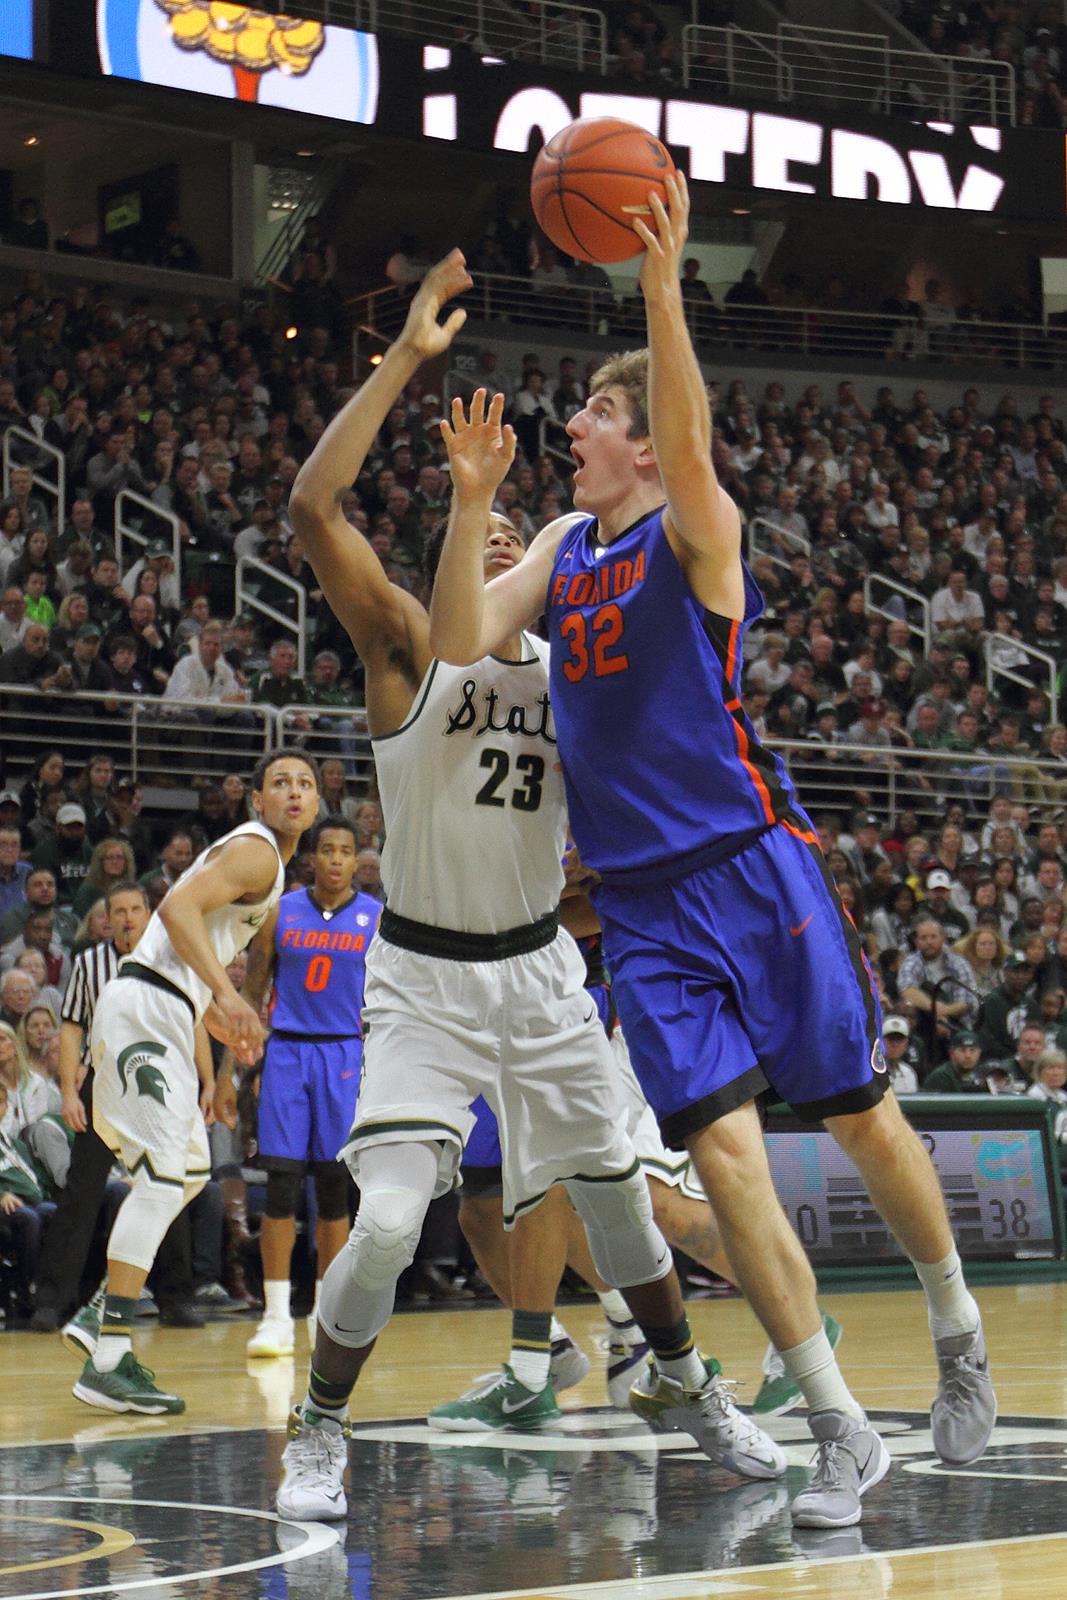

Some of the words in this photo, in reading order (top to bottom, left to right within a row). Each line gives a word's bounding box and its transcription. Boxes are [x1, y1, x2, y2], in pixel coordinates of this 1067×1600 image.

[552, 549, 646, 606] FOIDA
[560, 603, 630, 684] 32
[443, 679, 557, 745] Stat
[475, 748, 545, 812] 23
[281, 929, 365, 953] FLORIDA
[304, 954, 333, 993] 0
[784, 1203, 818, 1247] 0
[989, 1198, 1030, 1239] 38
